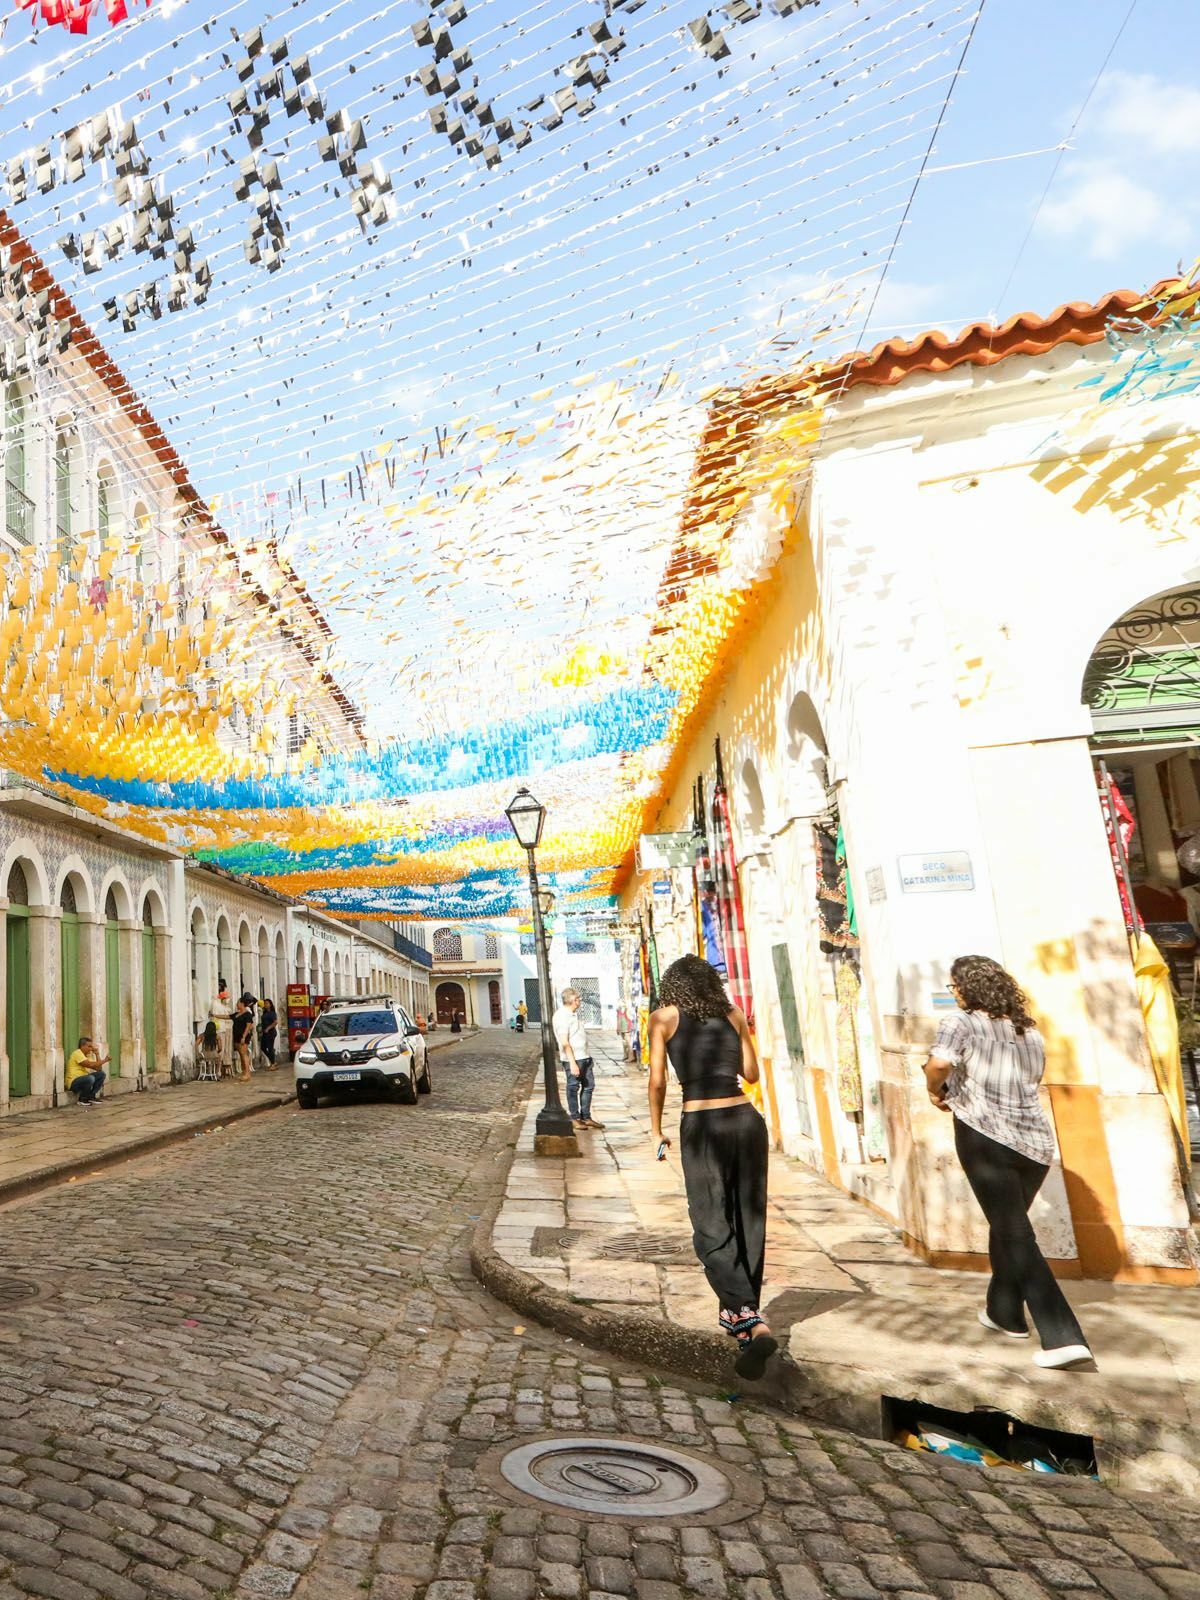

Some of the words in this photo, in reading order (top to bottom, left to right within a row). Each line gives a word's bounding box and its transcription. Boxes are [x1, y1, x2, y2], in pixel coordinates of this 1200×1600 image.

[922, 862, 946, 871] BECO
[903, 875, 946, 885] CATARINA
[947, 873, 970, 882] MINA
